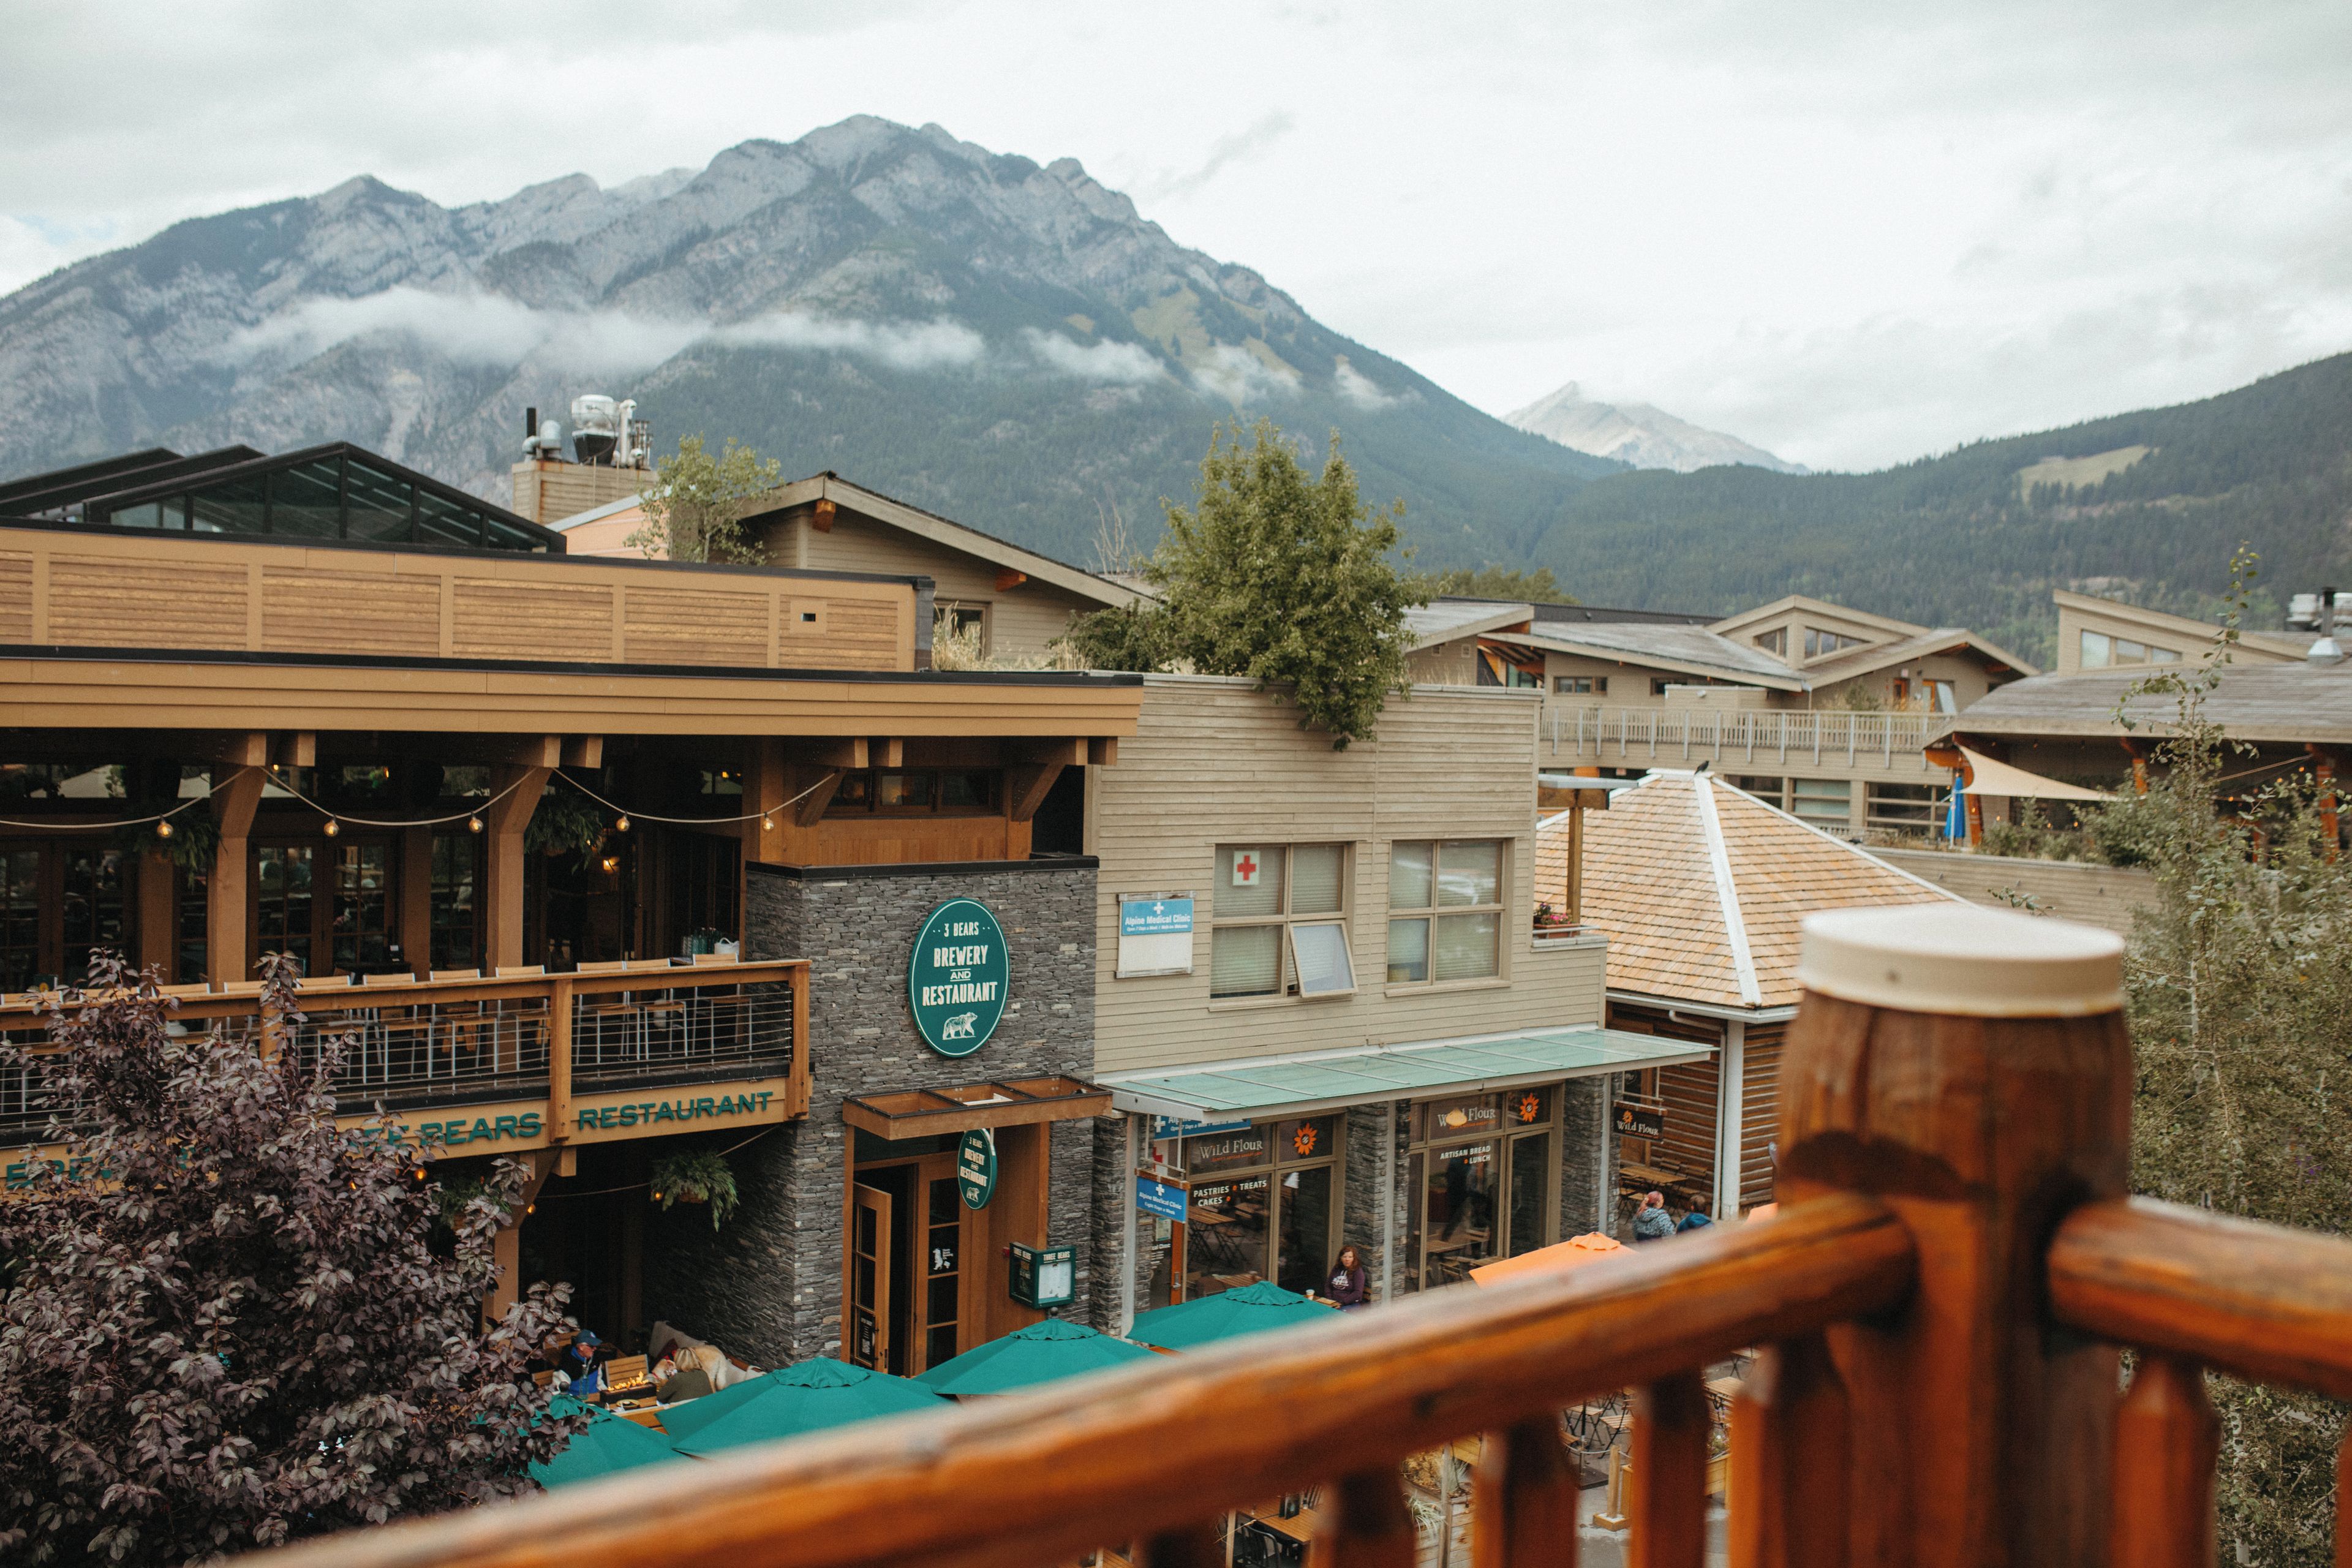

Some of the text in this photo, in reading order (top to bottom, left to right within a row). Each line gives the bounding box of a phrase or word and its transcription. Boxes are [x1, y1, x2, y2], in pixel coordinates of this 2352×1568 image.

[1125, 914, 1191, 927] Alpine Medical Clinic
[944, 922, 979, 937] 3 BEARS
[933, 945, 988, 968] BREWERY
[950, 971, 971, 979] AND
[922, 981, 998, 1006] RESTAURANT
[579, 1091, 773, 1130] RESTAURANT
[964, 1148, 985, 1166] BREWERY
[1440, 1145, 1491, 1159] ARTISAN BREAD
[1469, 1155, 1491, 1164] LUNCH
[960, 1166, 987, 1186] RESTAURANT
[1193, 1180, 1267, 1197] PASTRIES TREATS
[1152, 1196, 1169, 1205] Medical
[1169, 1201, 1182, 1210] Clinic
[1197, 1197, 1223, 1207] CAKES
